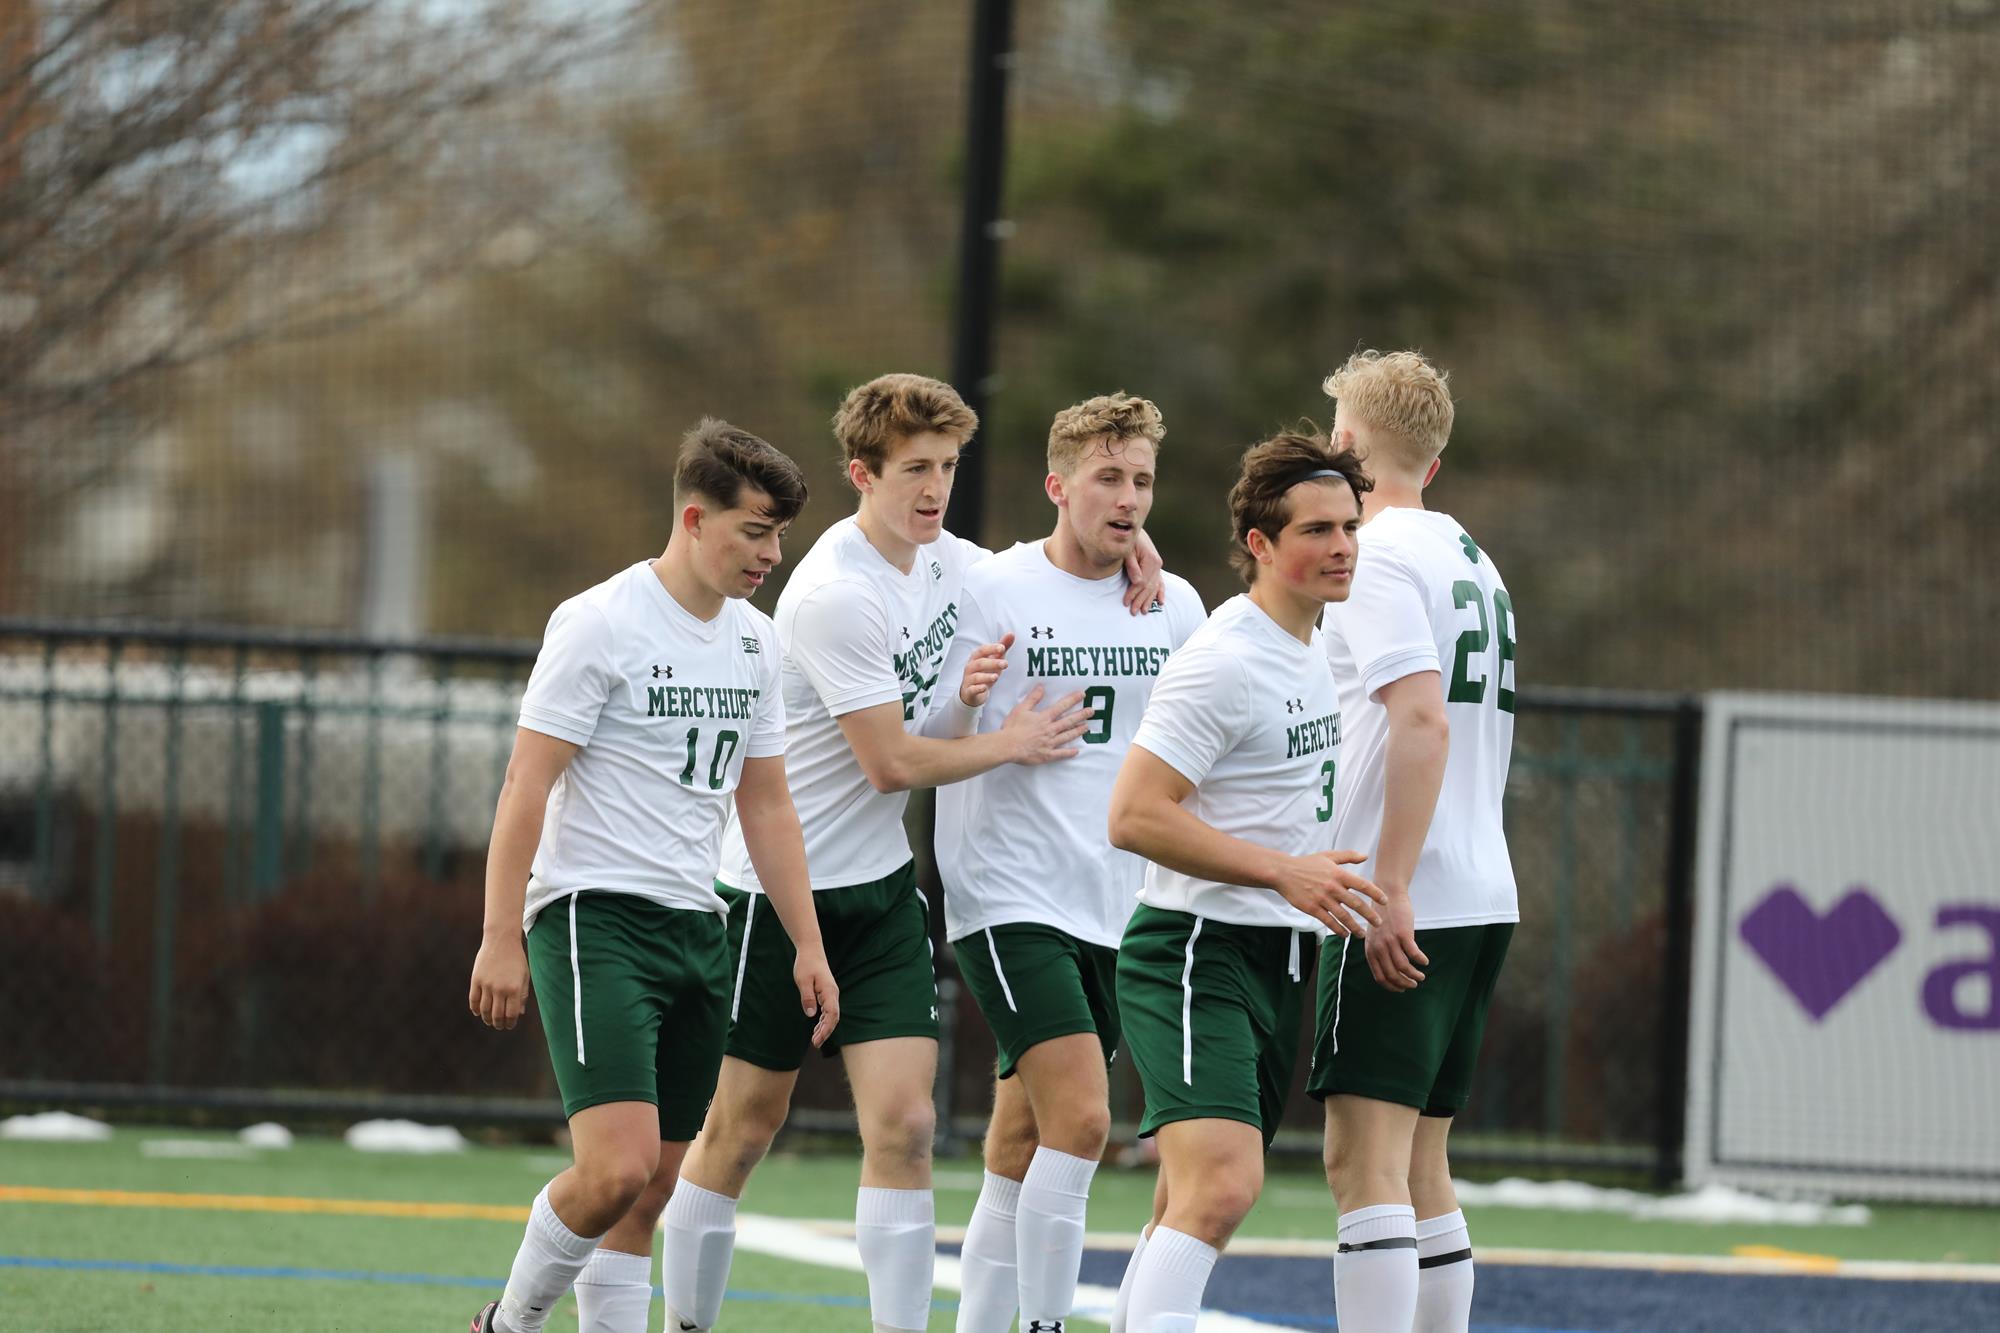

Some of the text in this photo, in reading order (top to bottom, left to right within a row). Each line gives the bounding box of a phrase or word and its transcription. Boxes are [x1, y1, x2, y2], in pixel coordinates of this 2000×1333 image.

[647, 686, 760, 720] MERCYHURT
[1082, 685, 1116, 744] 9
[679, 727, 740, 790] 10
[1315, 759, 1336, 823] 3
